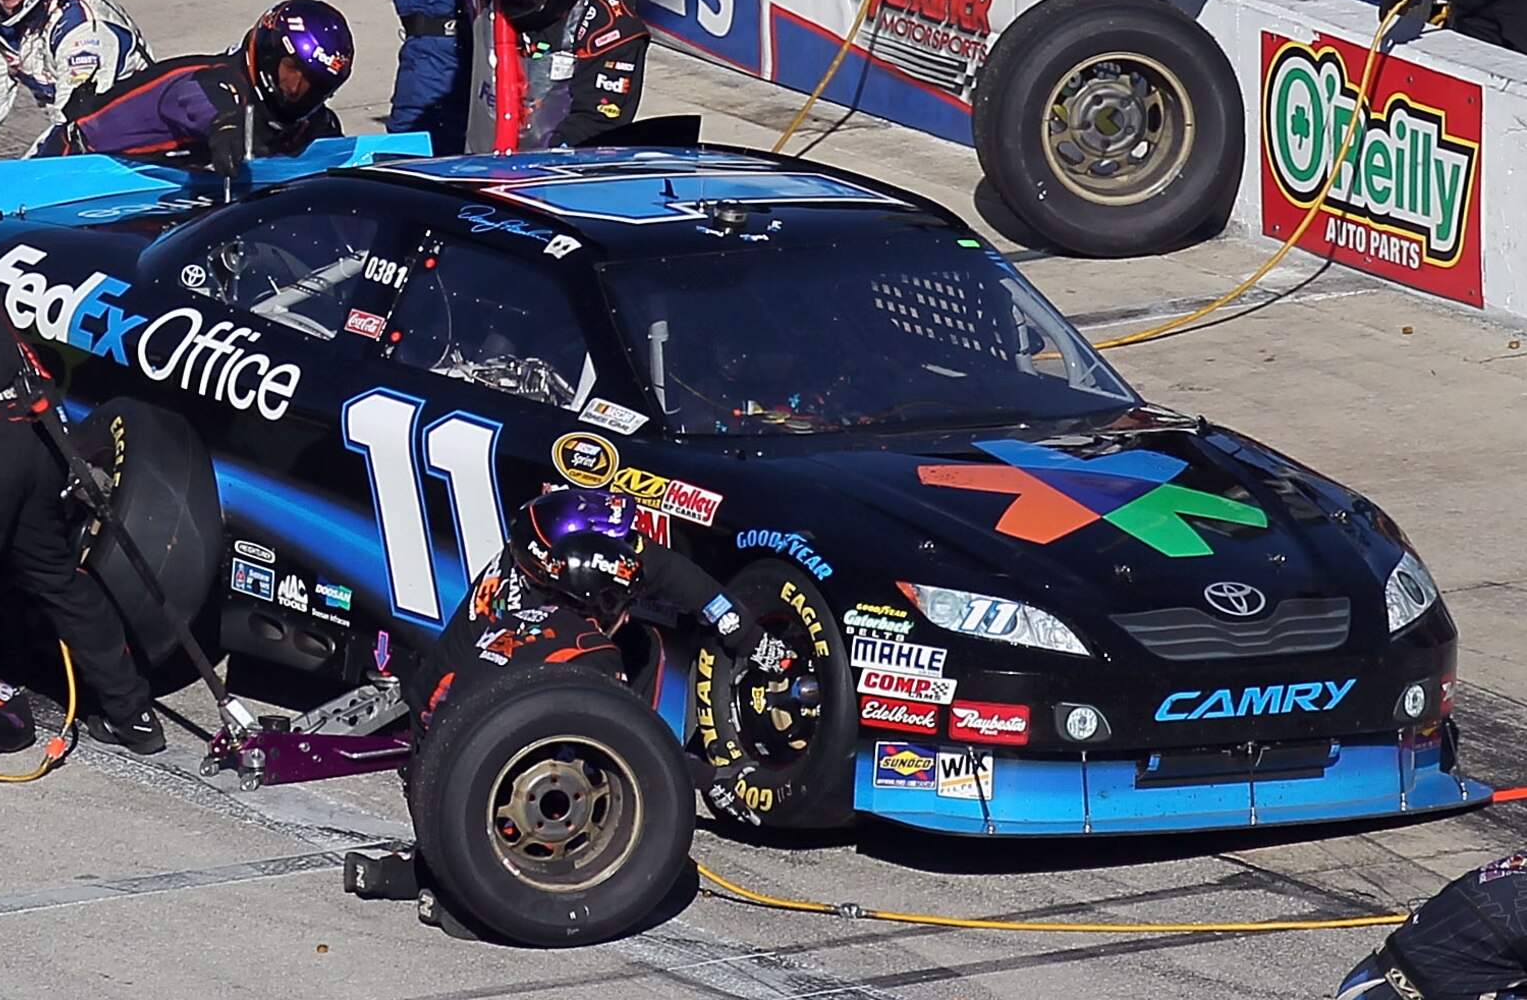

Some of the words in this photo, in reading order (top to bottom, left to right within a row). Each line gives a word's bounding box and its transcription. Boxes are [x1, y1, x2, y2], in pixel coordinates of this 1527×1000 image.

[287, 16, 305, 32] 11
[879, 12, 989, 63] MOTORSPORTS
[595, 73, 632, 94] FedE
[1272, 58, 1471, 249] O'Reilly
[1325, 216, 1366, 256] AUTO
[1368, 228, 1421, 271] PARTS
[364, 255, 407, 289] 0381
[137, 307, 302, 421] Office
[570, 452, 597, 469] Sprint
[341, 386, 510, 630] 11
[667, 482, 716, 523] Holley
[675, 506, 704, 522] CARBS
[591, 552, 640, 582] FedEx
[736, 528, 833, 581] GOODYEAR
[277, 574, 309, 604] MAC
[315, 583, 352, 603] DOOSAN
[278, 596, 308, 613] TOOLS
[778, 580, 830, 659] EAGLE
[855, 602, 908, 618] GOODYEAR
[959, 599, 1023, 635] 11
[843, 609, 915, 635] Gatorback
[845, 626, 905, 642] BELTS
[853, 638, 944, 672] MAHLE
[863, 671, 932, 696] COMP
[908, 690, 942, 702] CAMS
[861, 701, 936, 729] Edelbrock
[1155, 678, 1358, 723] CAMRY
[952, 706, 1028, 737] Raybestos
[880, 756, 933, 771] SUNOCO
[940, 752, 990, 780] WIX
